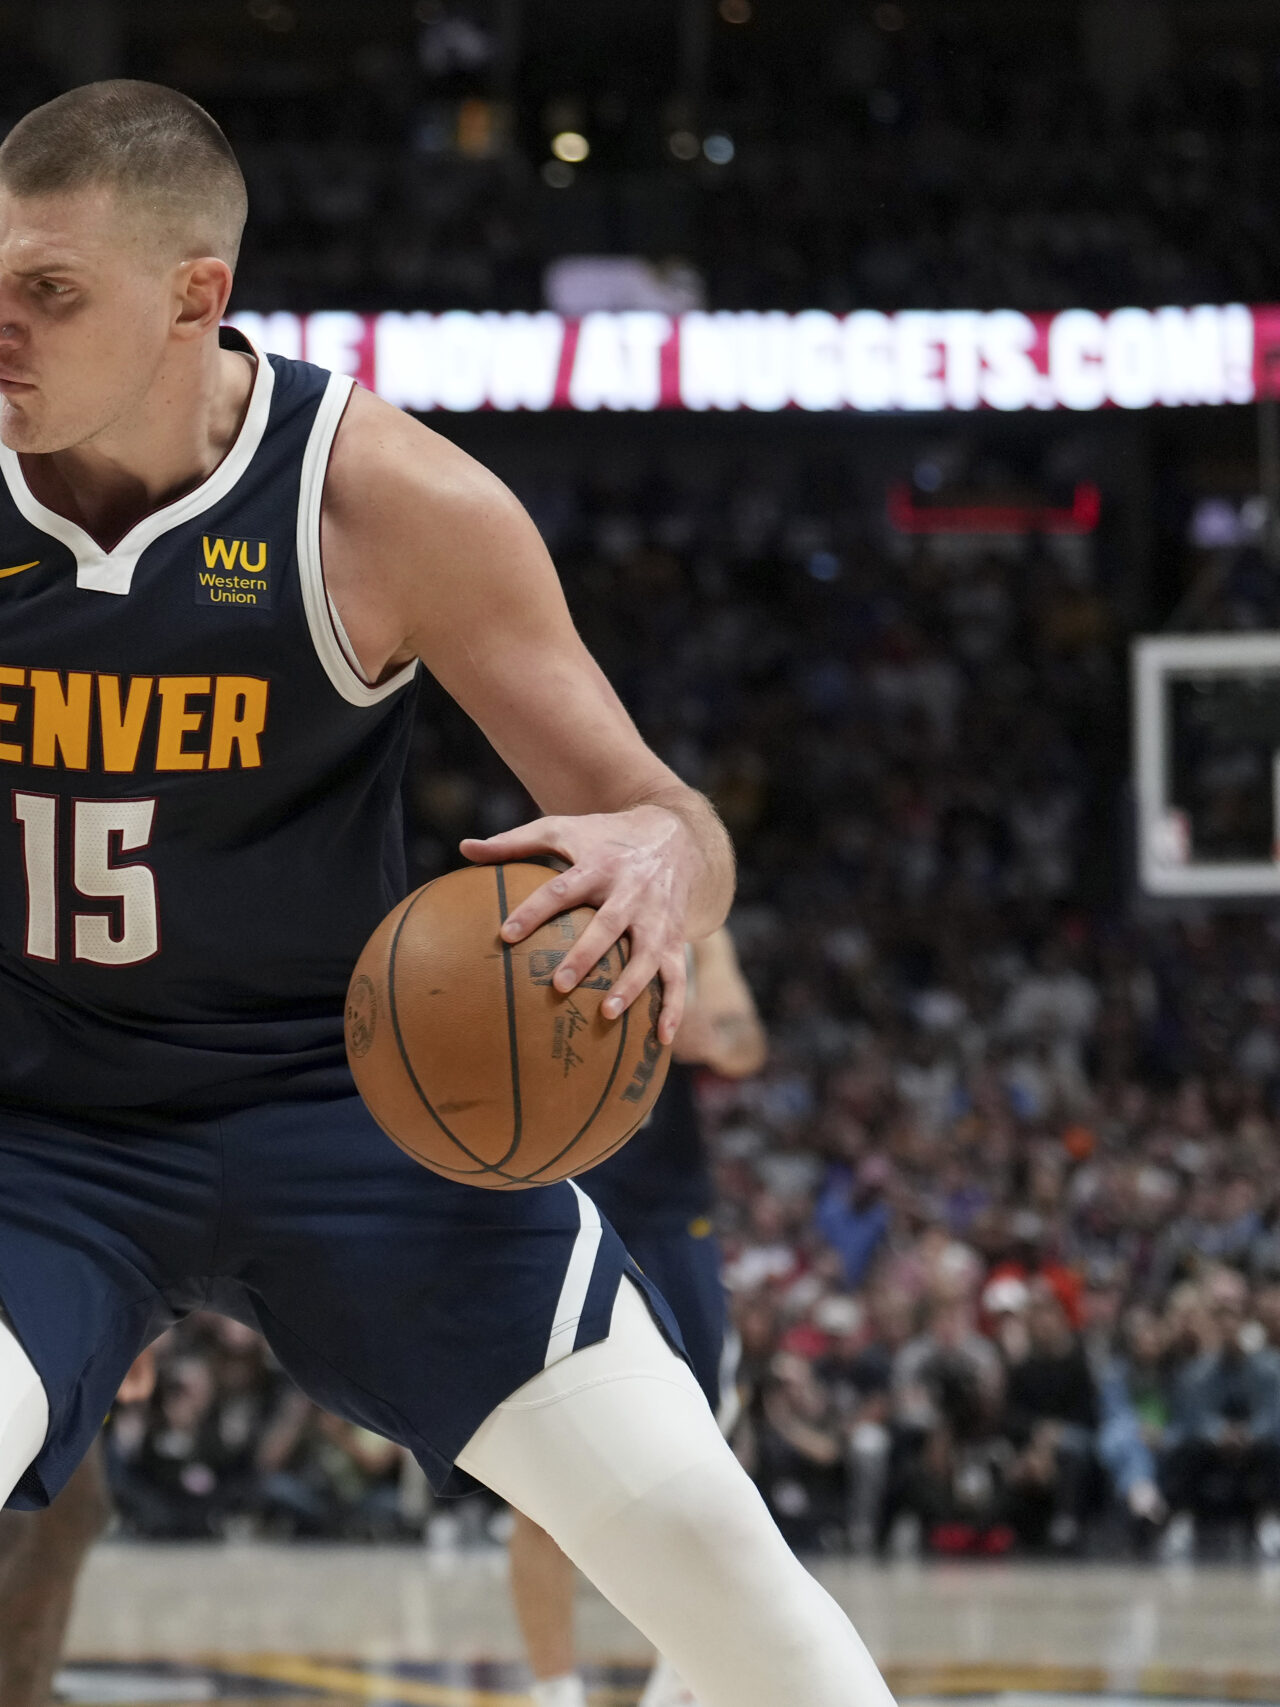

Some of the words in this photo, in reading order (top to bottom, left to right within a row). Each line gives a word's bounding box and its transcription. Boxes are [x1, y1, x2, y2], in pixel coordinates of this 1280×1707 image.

[374, 311, 565, 412] NOW
[569, 310, 673, 411] AT
[202, 535, 267, 573] WU
[199, 572, 267, 591] Western
[210, 588, 257, 605] Union
[11, 788, 162, 969] 15
